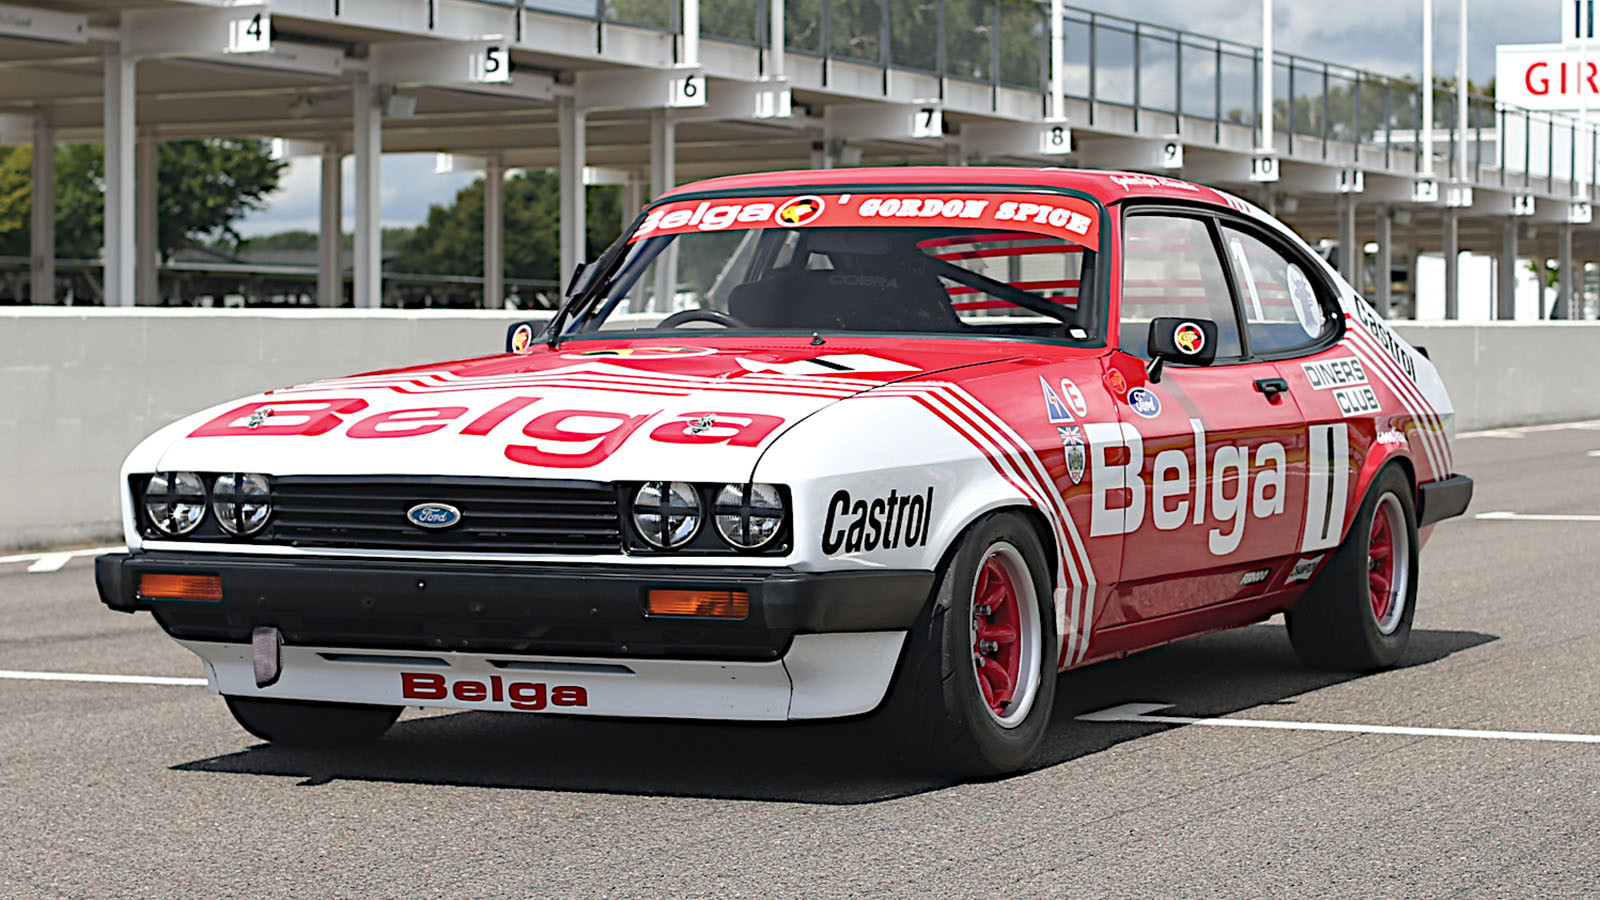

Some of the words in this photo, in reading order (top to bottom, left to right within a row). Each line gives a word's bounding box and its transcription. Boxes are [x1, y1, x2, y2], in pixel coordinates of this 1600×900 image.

[246, 14, 262, 41] 4
[485, 46, 500, 73] 5
[683, 75, 698, 98] 6
[920, 108, 935, 129] 7
[1052, 126, 1064, 146] 8
[1164, 142, 1177, 160] 9
[1252, 157, 1272, 174] 10
[858, 198, 989, 219] GORDON
[995, 201, 1092, 235] SPICE
[828, 273, 899, 289] COBRA
[1353, 295, 1416, 382] Castrol
[1303, 359, 1366, 387] DINERS
[1133, 390, 1156, 412] Ford
[1336, 388, 1378, 414] CLUB
[185, 396, 786, 468] Belga
[1083, 418, 1287, 556] Belga
[418, 507, 449, 523] Ford
[821, 486, 934, 555] Castrol
[401, 672, 588, 710] Belga
